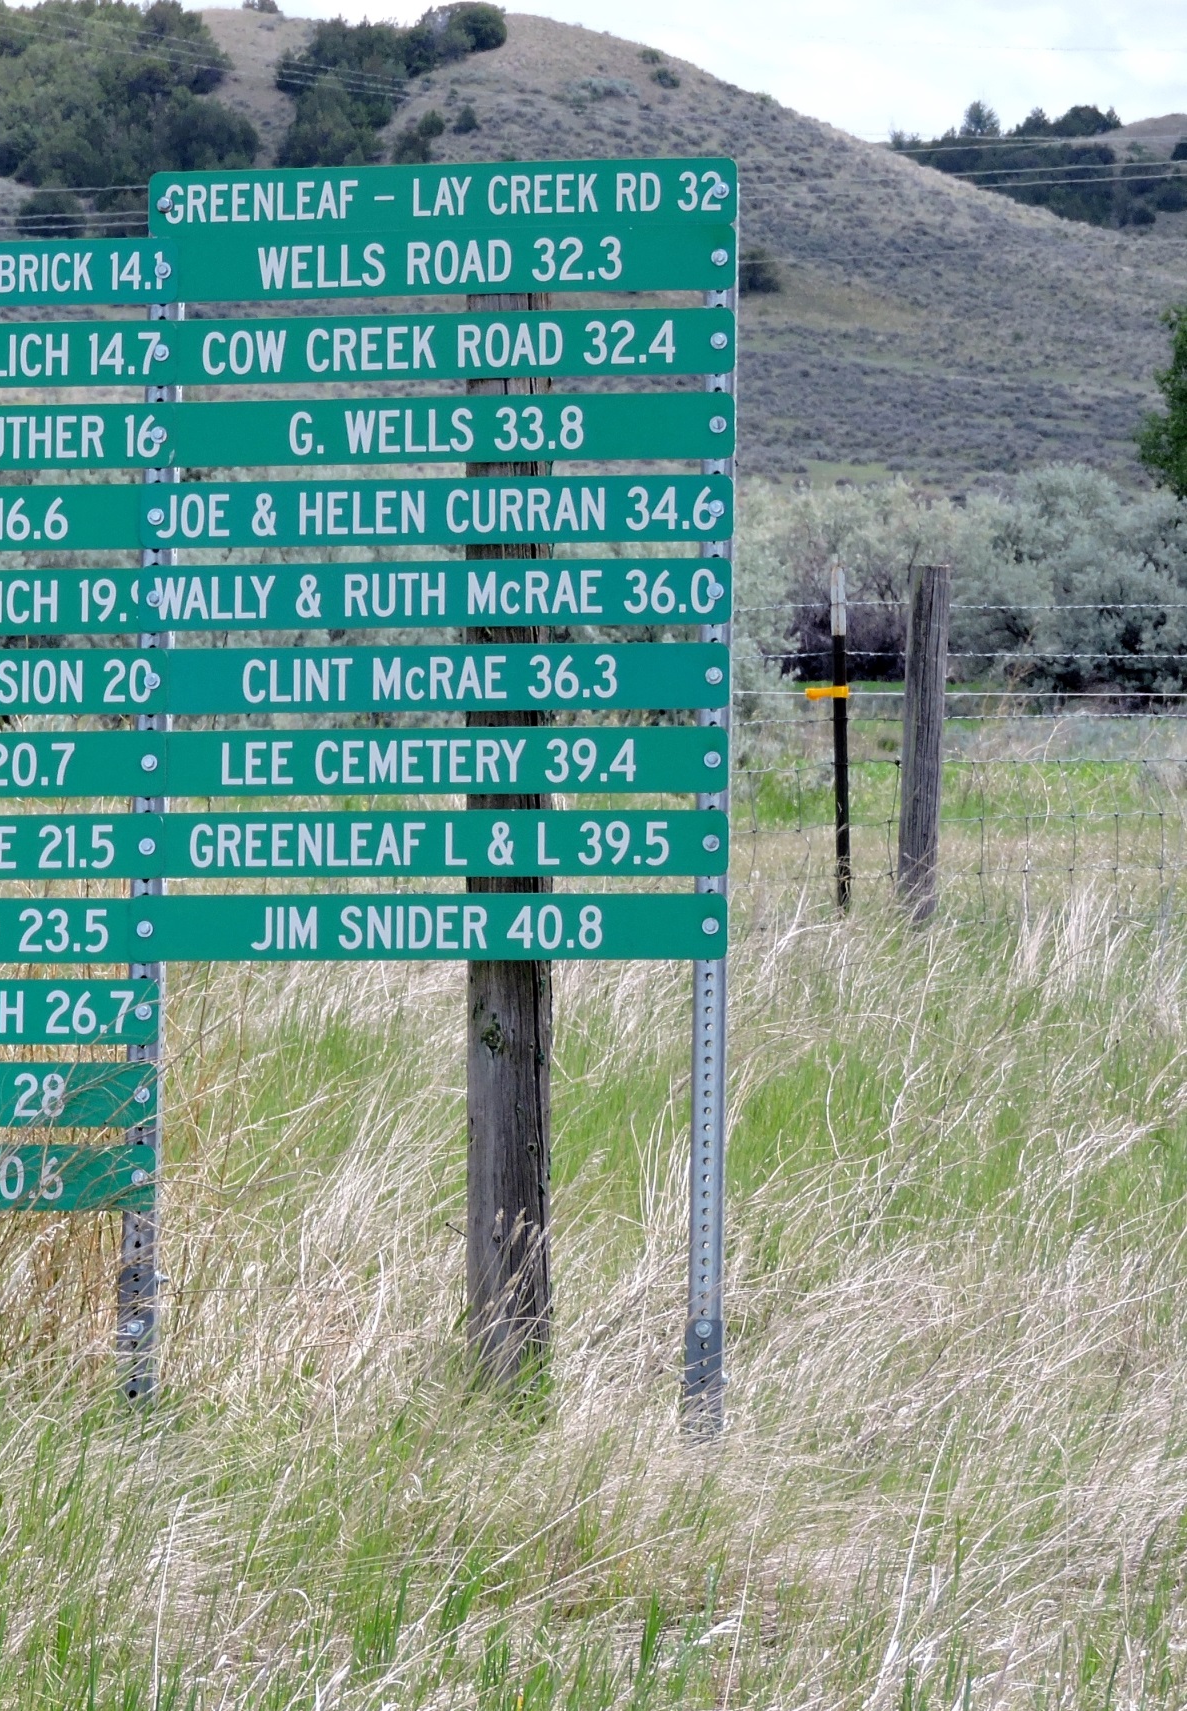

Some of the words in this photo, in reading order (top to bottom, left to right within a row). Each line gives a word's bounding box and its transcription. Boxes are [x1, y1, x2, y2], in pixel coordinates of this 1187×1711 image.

[165, 180, 358, 224] GREENLEAF
[413, 177, 471, 216] LAY
[488, 174, 598, 215] CREEK
[617, 173, 660, 211] RD
[678, 171, 722, 211] 32
[111, 252, 164, 290] 14.1
[258, 243, 385, 289] WELLS
[407, 240, 511, 284] ROAD
[532, 237, 622, 281] 32.3
[89, 332, 160, 375] 14.7
[203, 331, 286, 375] COW
[307, 326, 435, 372] CREEK
[458, 323, 562, 367] ROAD
[584, 320, 675, 364] 32.4
[125, 415, 159, 457] 16
[290, 412, 324, 455] G.
[345, 408, 473, 453] WELLS
[495, 406, 583, 451] 33.8
[156, 494, 229, 538] JOE
[252, 493, 276, 536] &
[300, 491, 424, 535] HELEN
[447, 488, 605, 533] CURRAN
[626, 487, 717, 530] 34.6
[80, 579, 138, 622] 19.
[155, 576, 275, 619] WALLY
[296, 574, 321, 618] &
[345, 573, 445, 617] RUTH
[468, 570, 602, 614] McRAE
[624, 569, 716, 613] 36.0
[104, 659, 151, 702] 20
[243, 658, 352, 703] CLINT
[373, 656, 506, 700] McRAE
[529, 655, 617, 698] 36.3
[222, 742, 293, 784] LEE
[316, 740, 526, 784] CEMETERY
[545, 739, 636, 782] 39.4
[39, 825, 114, 868] 21.5
[190, 823, 425, 868] GREENLEAF
[446, 823, 467, 865] L
[488, 822, 513, 865] &
[538, 822, 559, 865] L
[579, 821, 669, 865] 39.5
[19, 909, 108, 952] 23.5
[251, 907, 317, 950] JIM
[339, 906, 487, 949] SNIDER
[507, 905, 602, 949] 40.8
[46, 990, 135, 1034] 26.7
[14, 1073, 65, 1116] 28
